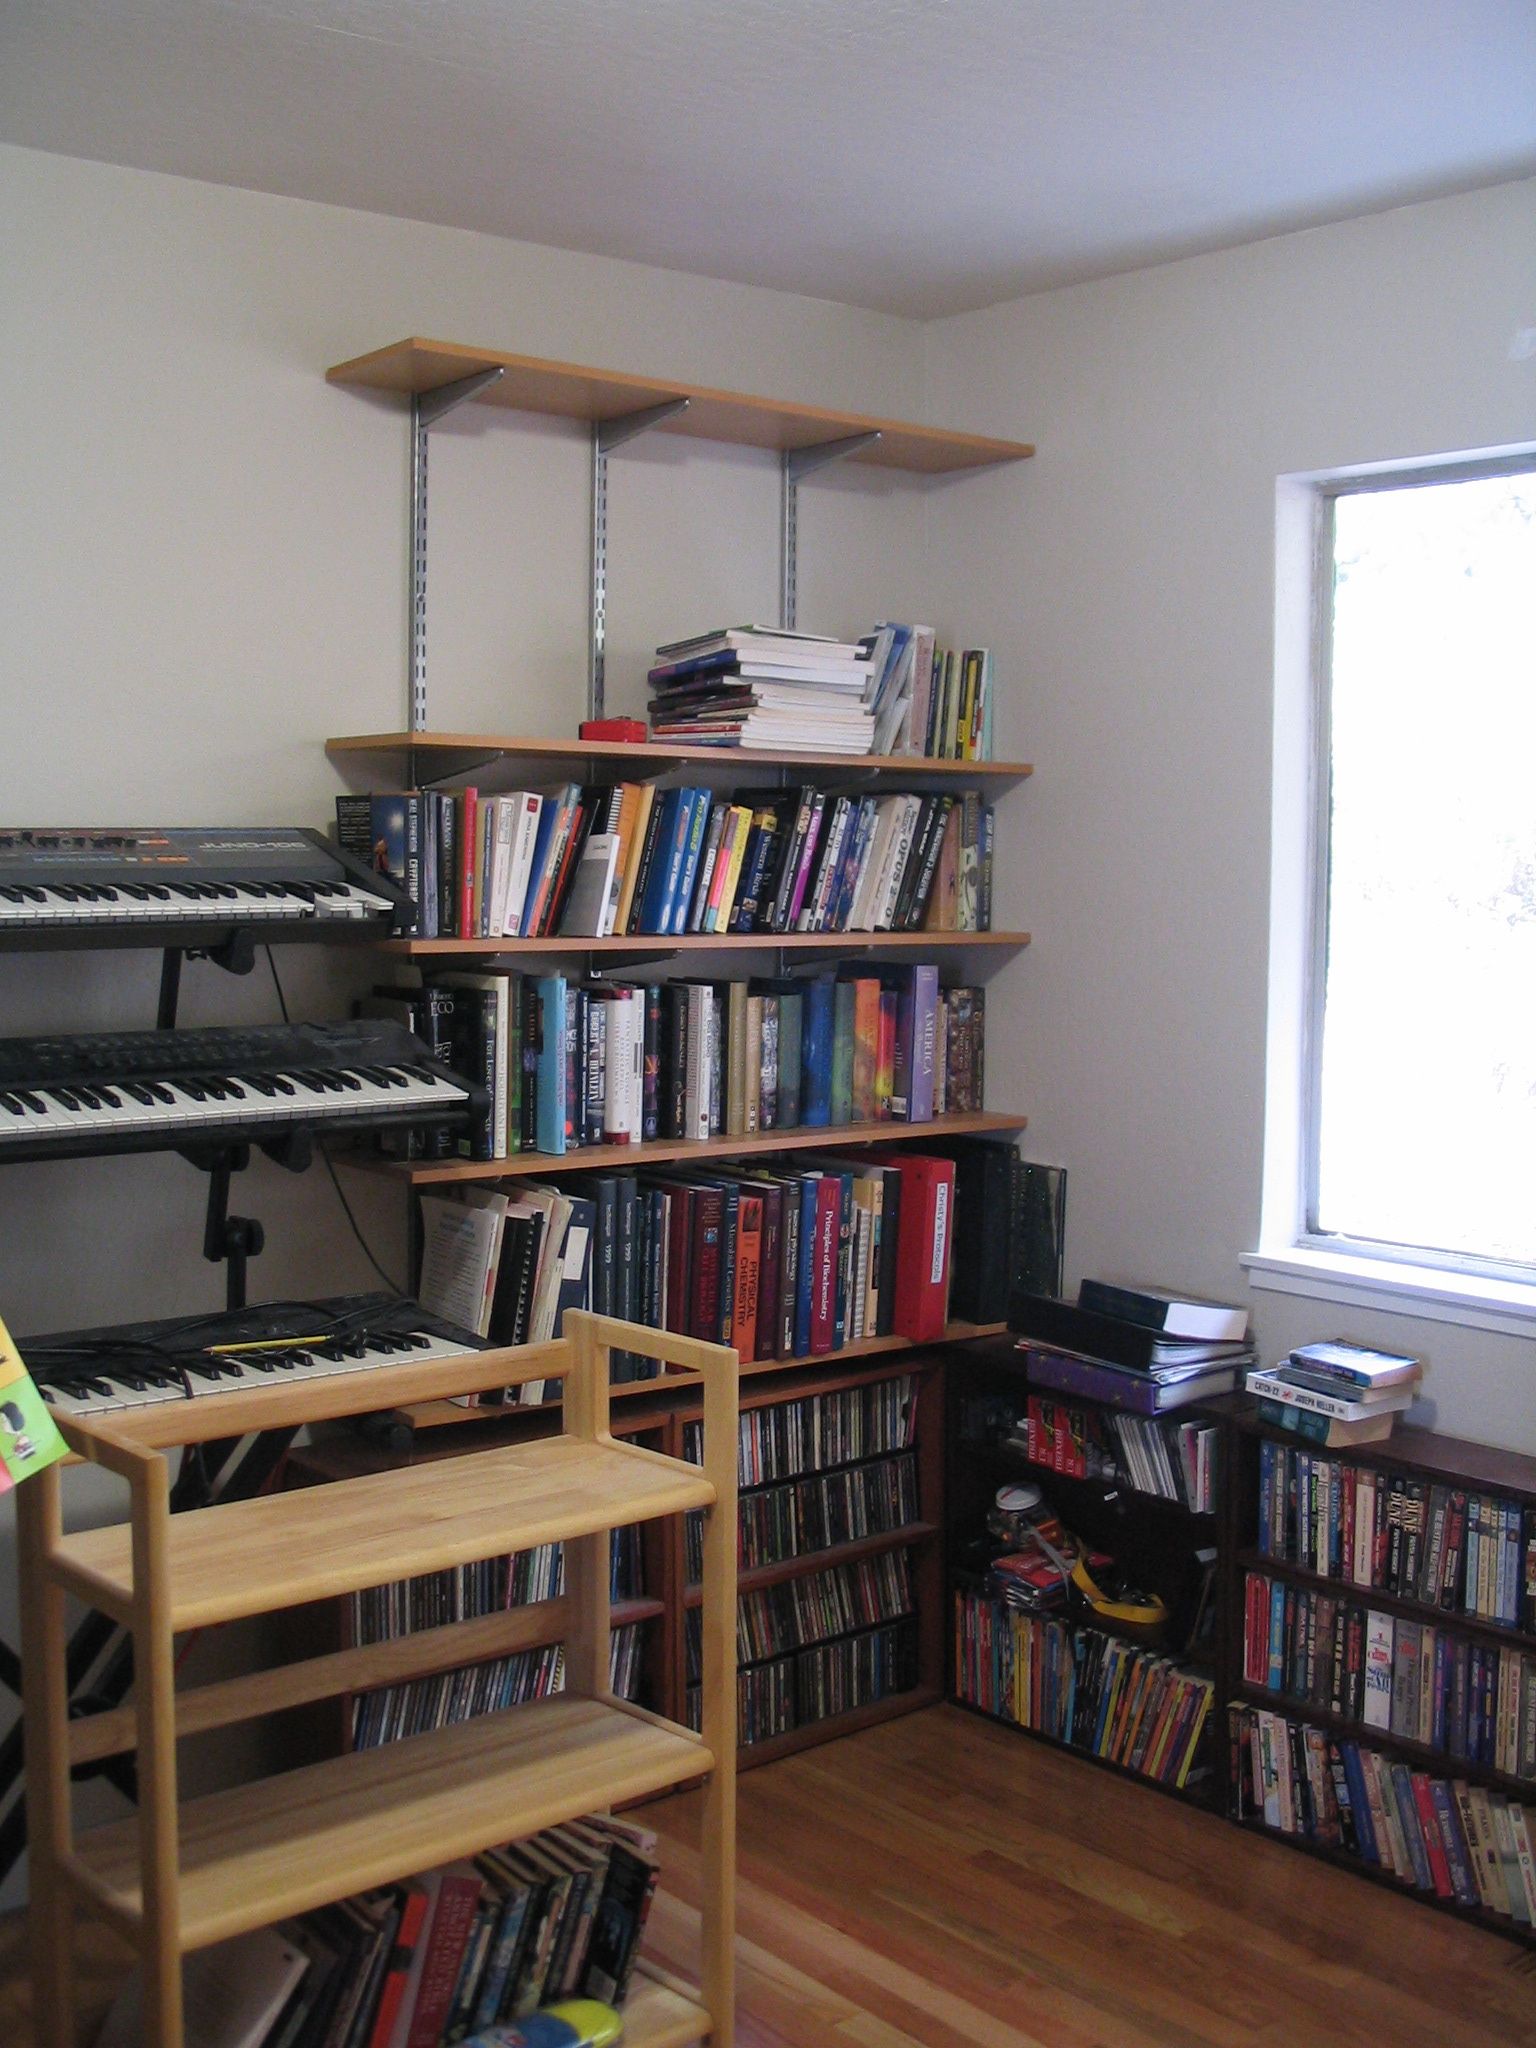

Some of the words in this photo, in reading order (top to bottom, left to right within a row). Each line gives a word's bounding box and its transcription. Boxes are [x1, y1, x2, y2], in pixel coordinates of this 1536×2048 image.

[757, 835, 772, 869] Western
[892, 839, 908, 883] OPUS
[431, 1001, 454, 1017] ECO
[485, 1039, 494, 1055] For
[923, 1009, 935, 1075] AMERICA
[485, 1060, 494, 1081] Love
[936, 1185, 946, 1230] Christy's
[727, 1223, 737, 1267] Microbial
[823, 1210, 834, 1253] Principles
[789, 1238, 798, 1281] physiology
[823, 1254, 831, 1263] of
[932, 1233, 943, 1281] Protocols
[725, 1270, 735, 1312] Genetics
[737, 1257, 748, 1327] CHEMISTRY
[746, 1261, 757, 1320] PHYSICAL
[819, 1265, 830, 1320] Biochemistry
[1255, 1380, 1280, 1397] CATCH-22
[1294, 1392, 1315, 1407] JOSEPH
[1316, 1399, 1335, 1413] HELLER
[1389, 1492, 1402, 1526] DUNE
[1403, 1499, 1418, 1533] DUNE
